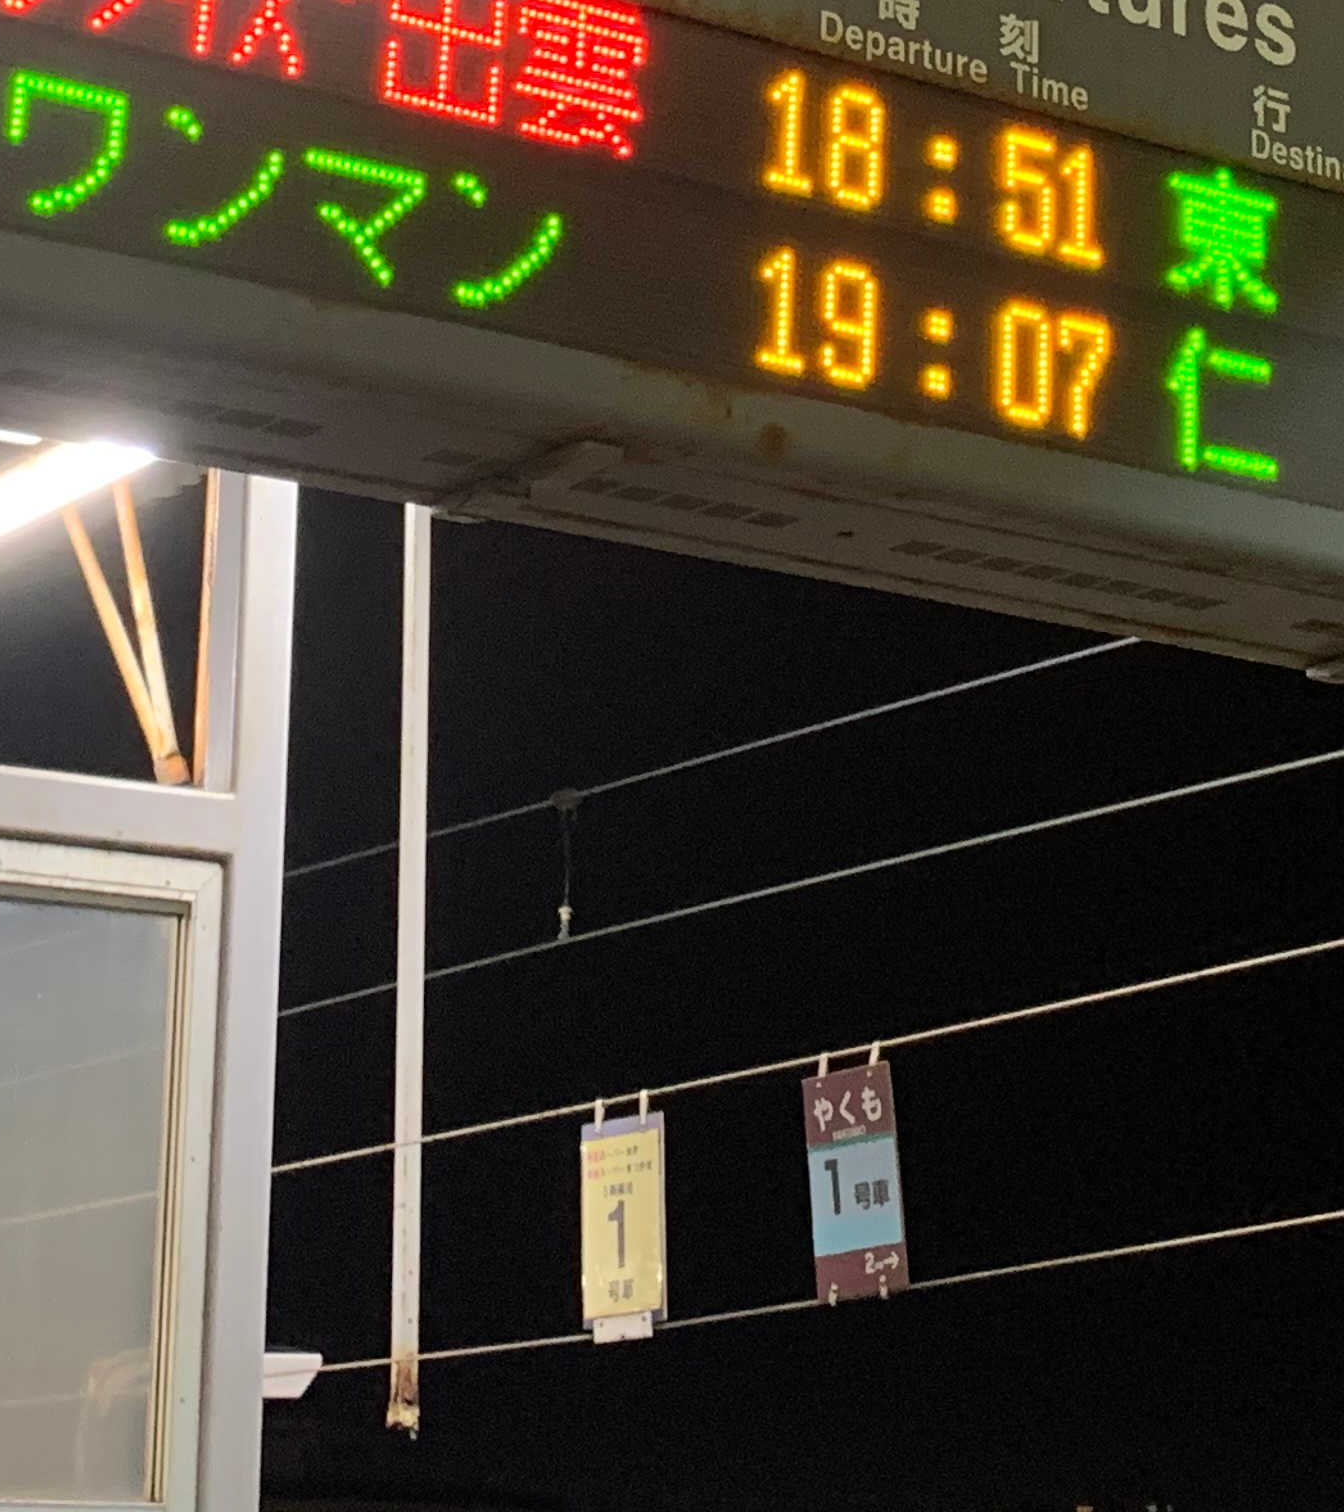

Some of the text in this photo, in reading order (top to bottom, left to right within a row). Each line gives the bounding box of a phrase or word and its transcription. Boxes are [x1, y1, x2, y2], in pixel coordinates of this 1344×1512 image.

[820, 9, 1089, 111] Departure Time
[8, 72, 560, 304] ワンマン
[764, 70, 1104, 268] 18:51
[754, 249, 1112, 439] 19:07
[814, 1086, 882, 1133] やくも
[608, 1200, 625, 1268] 1
